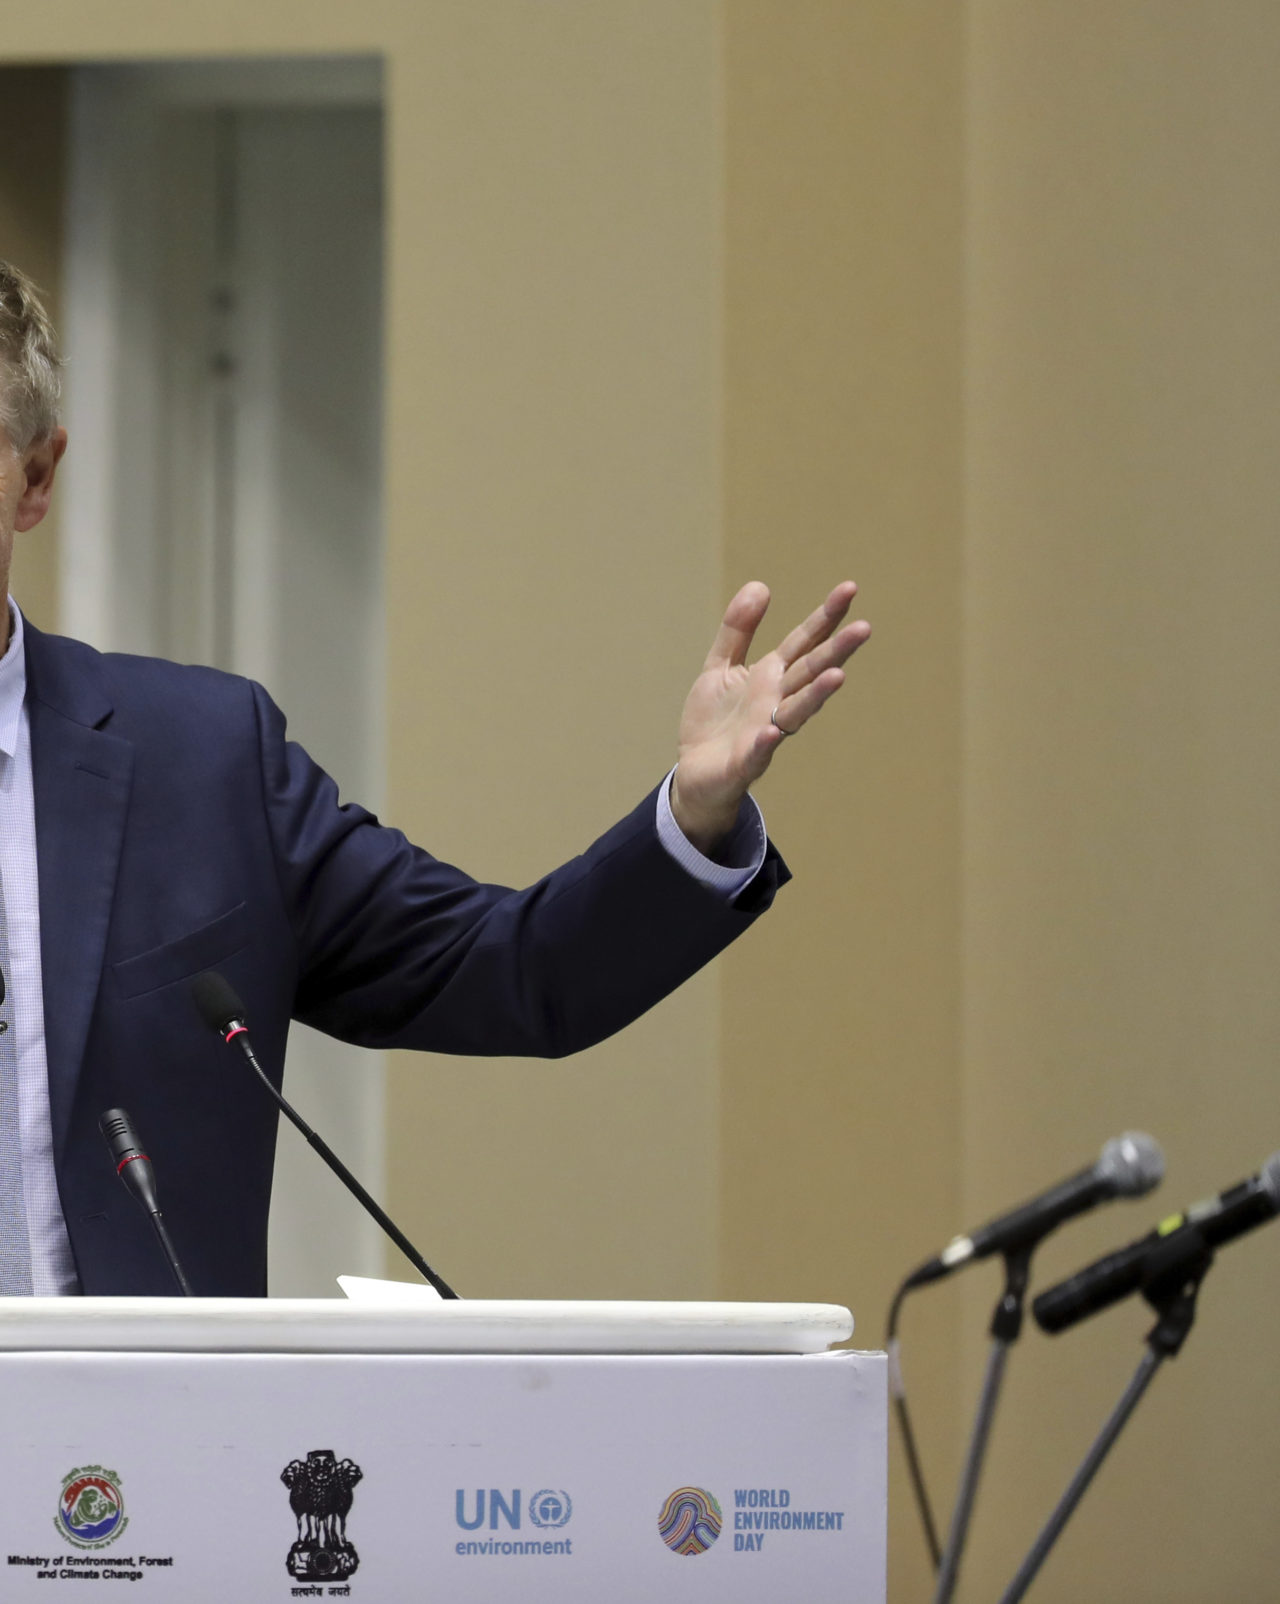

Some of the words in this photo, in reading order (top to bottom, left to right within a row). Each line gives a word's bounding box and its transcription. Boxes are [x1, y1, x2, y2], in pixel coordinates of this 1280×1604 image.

[734, 1489, 791, 1508] WORLD
[456, 1489, 521, 1531] UN
[734, 1511, 845, 1530] ENVIRONMENT
[456, 1538, 572, 1555] environment
[734, 1533, 764, 1552] DAY
[8, 1556, 49, 1568] Ministry
[53, 1556, 63, 1566] of
[66, 1556, 136, 1567] Environment,
[139, 1556, 173, 1566] Forest
[37, 1569, 57, 1579] and
[60, 1569, 100, 1579] Climate
[102, 1569, 143, 1581] Change
